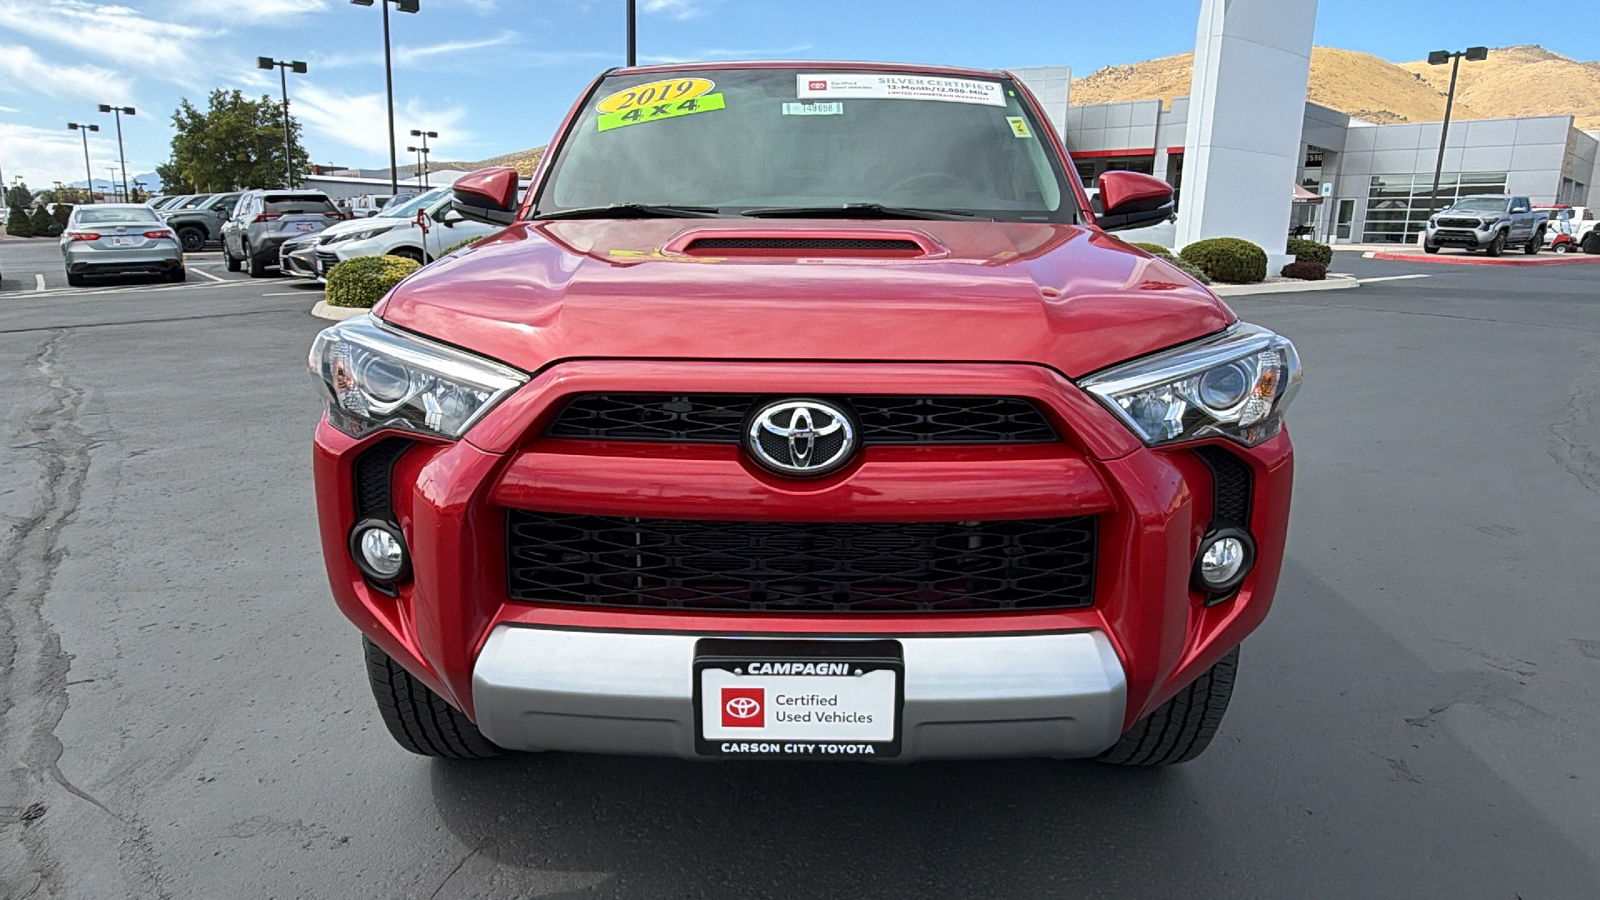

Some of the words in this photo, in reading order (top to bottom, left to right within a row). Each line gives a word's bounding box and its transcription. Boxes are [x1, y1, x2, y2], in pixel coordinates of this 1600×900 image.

[878, 77, 925, 86] SILVER
[927, 80, 995, 91] CERTIFIED
[616, 80, 694, 110] 2019
[747, 663, 849, 675] CAMPAGNI
[775, 695, 837, 706] Certified
[775, 711, 811, 723] Used
[815, 712, 873, 724] Vehicles
[721, 743, 780, 753] CARSON
[784, 744, 815, 753] CITY
[818, 744, 875, 754] TOYOTA
